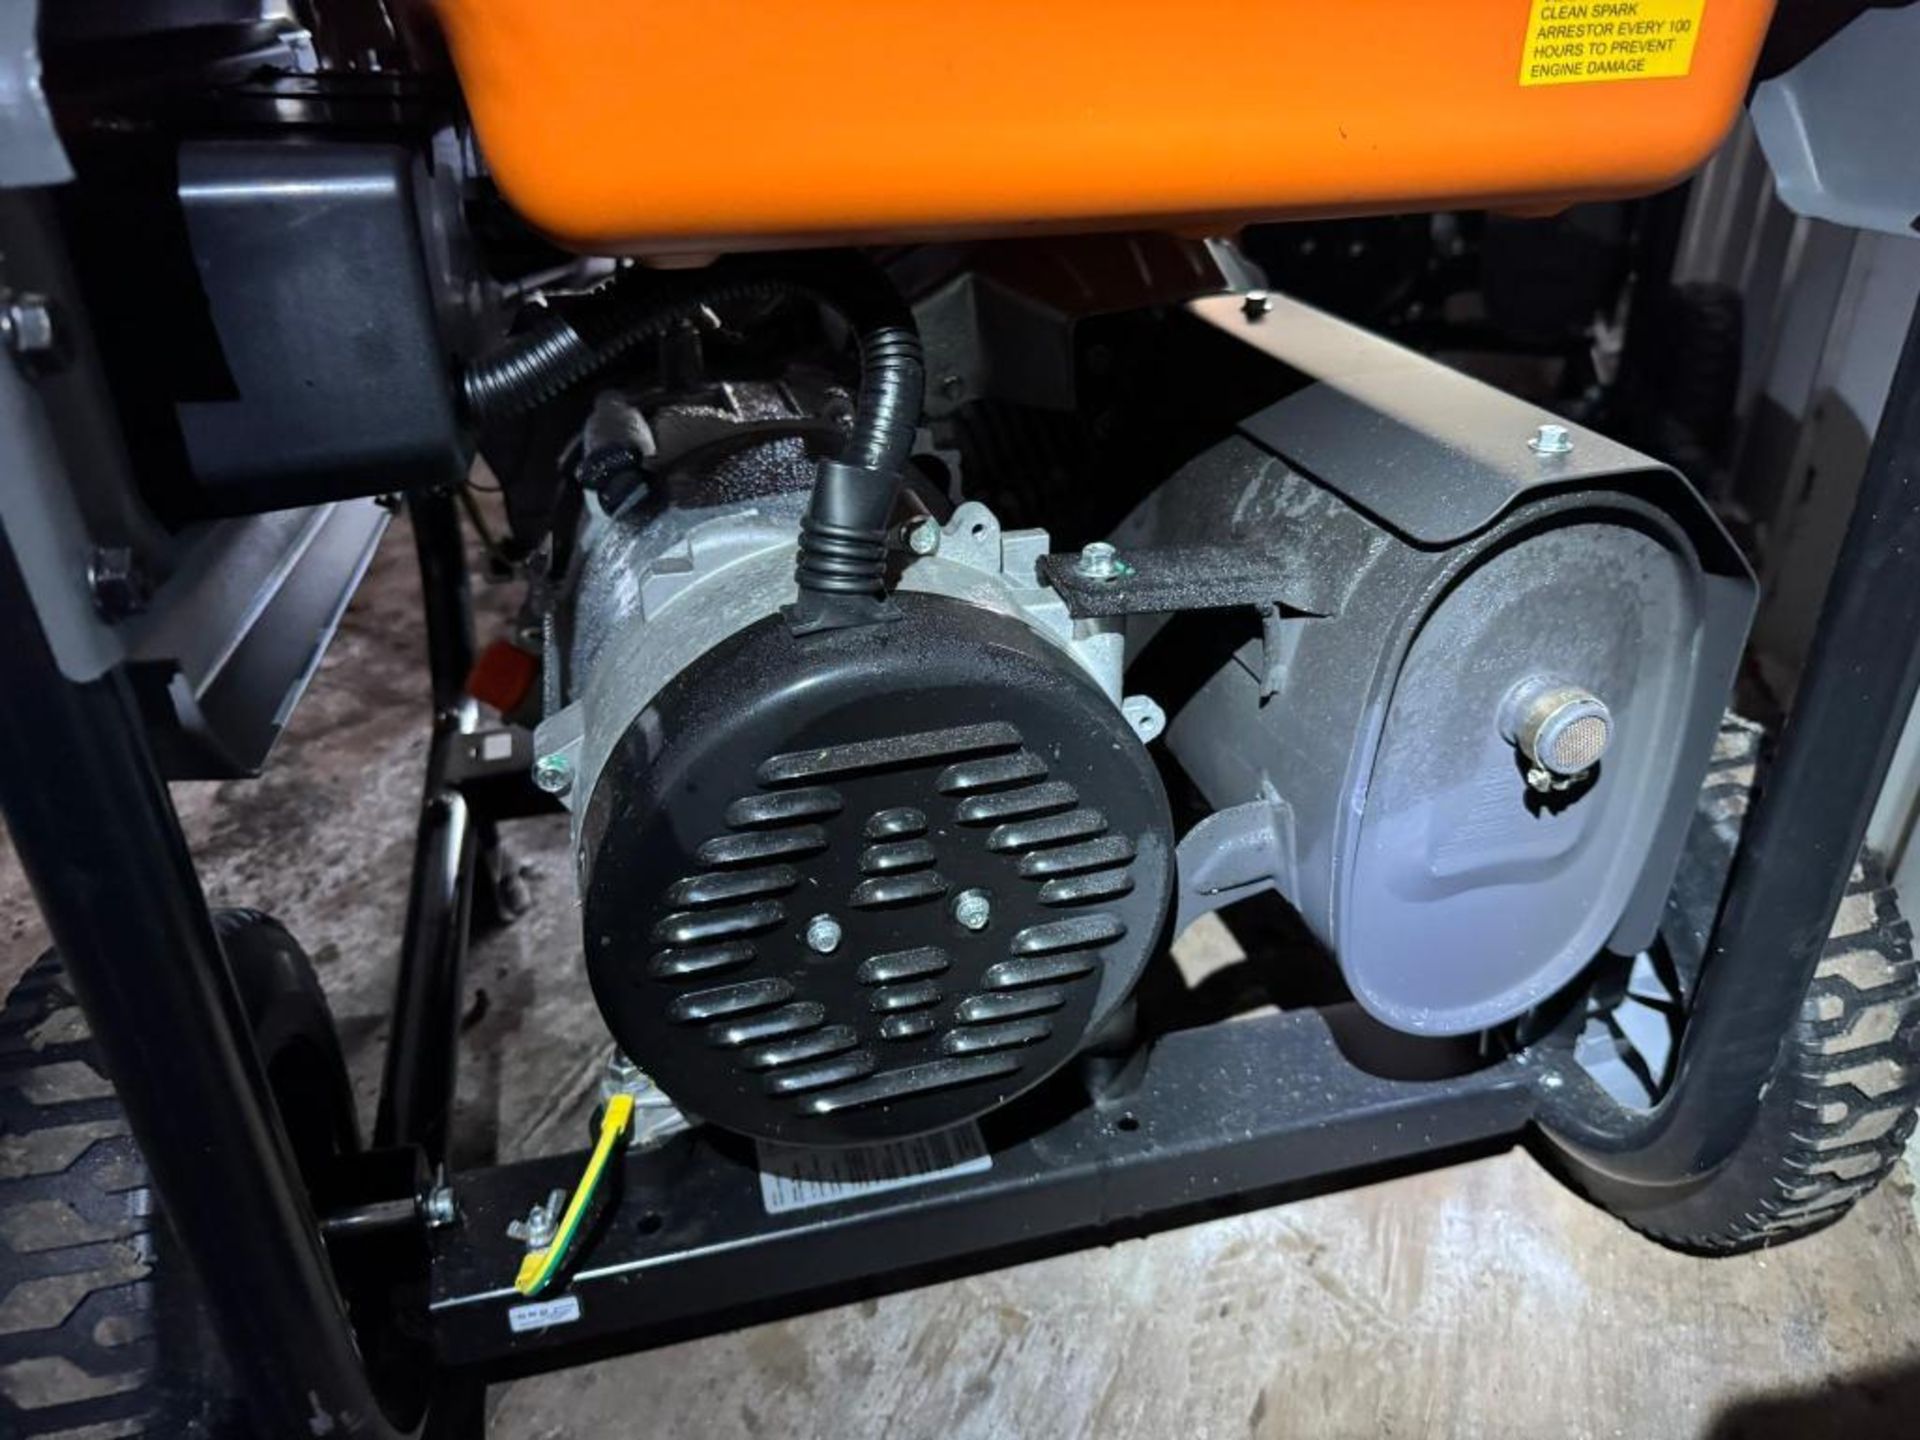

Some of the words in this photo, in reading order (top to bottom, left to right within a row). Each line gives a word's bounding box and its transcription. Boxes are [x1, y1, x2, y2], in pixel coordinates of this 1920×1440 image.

[1541, 6, 1588, 20] CLEAN
[1591, 3, 1638, 18] SPARK
[1536, 22, 1614, 40] ARRESTOR
[1617, 20, 1664, 35] EVERY
[1669, 19, 1691, 33] 100
[1533, 43, 1584, 60] HOURS
[1588, 42, 1607, 56] TO
[1610, 38, 1676, 54] PREVENT
[1530, 62, 1582, 78] ENGINE
[1586, 58, 1645, 74] DAMAGE
